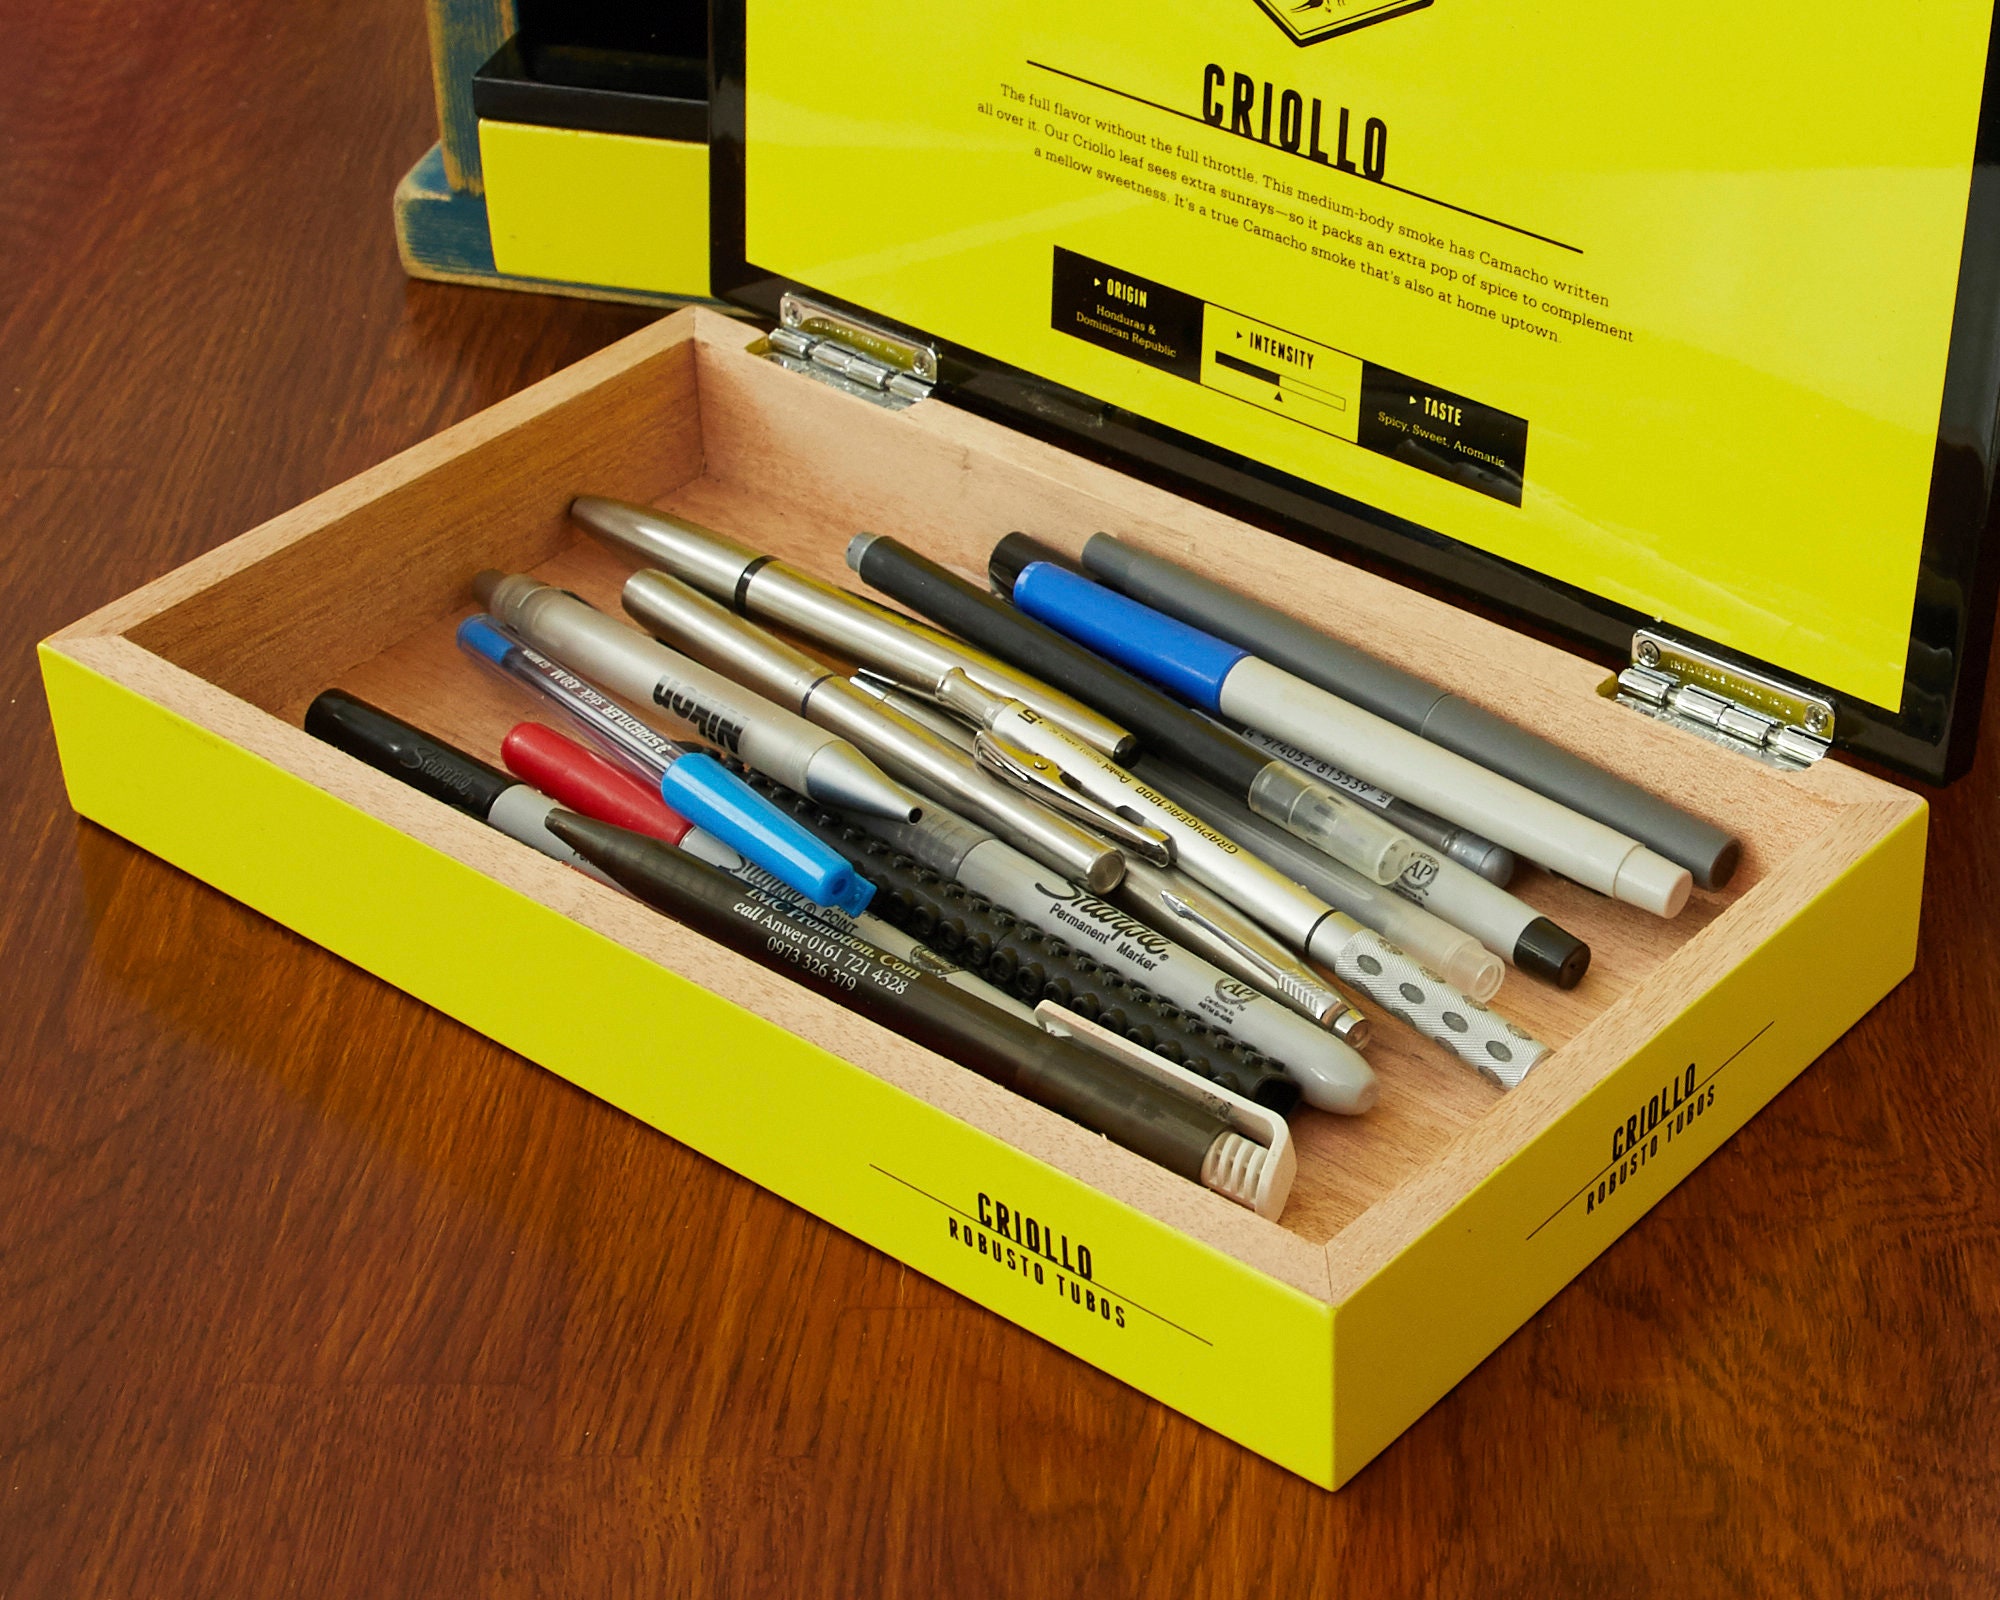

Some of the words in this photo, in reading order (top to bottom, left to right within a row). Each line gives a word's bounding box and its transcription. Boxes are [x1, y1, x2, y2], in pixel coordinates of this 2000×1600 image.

[1202, 63, 1388, 182] CRIOLLO
[977, 102, 993, 116] all
[996, 109, 1024, 127] over
[1027, 119, 1041, 134] it.
[1044, 123, 1070, 143] Our
[1072, 133, 1116, 159] Criollo
[1119, 148, 1145, 170] leaf
[1147, 162, 1178, 181] sees
[1180, 174, 1217, 196] extra
[1307, 215, 1318, 231] it
[1321, 223, 1364, 247] packs
[1366, 239, 1385, 255] an
[1388, 247, 1427, 270] extra
[1429, 262, 1458, 282] pop
[1461, 273, 1478, 287] of
[1479, 280, 1519, 302] spice
[1522, 293, 1538, 309] to
[1541, 302, 1634, 343] complement
[1000, 82, 1026, 104] The
[1028, 93, 1051, 112] full
[1053, 101, 1092, 126] flavor
[1094, 118, 1147, 146] without
[1150, 136, 1173, 155] the
[1176, 144, 1199, 164] full
[1202, 155, 1258, 185] throttle.
[1262, 174, 1294, 197] This
[1296, 189, 1395, 234] medium-body
[1397, 225, 1445, 250] smoke
[1448, 239, 1476, 260] has
[1478, 250, 1549, 286] Camacho
[1553, 279, 1609, 308] written
[1033, 147, 1042, 158] a
[1045, 150, 1093, 175] mellow
[1096, 168, 1170, 203] sweetness.
[1198, 205, 1207, 217] a
[1210, 208, 1240, 228] true
[1242, 218, 1308, 253] Camacho
[1310, 245, 1357, 270] smoke
[1404, 278, 1435, 298] also
[1437, 291, 1453, 305] at
[1456, 293, 1497, 321] home
[1500, 313, 1563, 343] uptown.
[1096, 304, 1146, 332] Honduras
[1147, 323, 1157, 336] &
[1106, 278, 1147, 308] ORIGIN
[1075, 311, 1130, 341] Dominican
[1131, 331, 1177, 359] Republic
[1250, 332, 1314, 370] INTENSITY
[1424, 396, 1463, 427] TASTE
[1453, 440, 1506, 468] Aromatic
[601, 704, 663, 748] STAEDTLER
[1403, 860, 1433, 881] AP
[733, 899, 764, 921] call
[760, 914, 808, 944] Anwer
[806, 935, 842, 962] 0161
[844, 953, 869, 976] 721
[870, 967, 908, 995] 4328
[820, 909, 858, 933] POINT
[1049, 902, 1110, 944] Permanent
[1116, 941, 1158, 972] Marker
[766, 936, 800, 963] 0973
[801, 955, 829, 978] 326
[830, 970, 857, 991] 379
[1612, 1063, 1696, 1163] CRIOLLO
[1586, 1135, 1658, 1215] ROBUSTO
[1666, 1085, 1715, 1143] TUBOS
[977, 1192, 1092, 1281] CRIOLLO
[948, 1216, 1044, 1286] ROBUSTO
[1056, 1273, 1126, 1329] TUBOS
